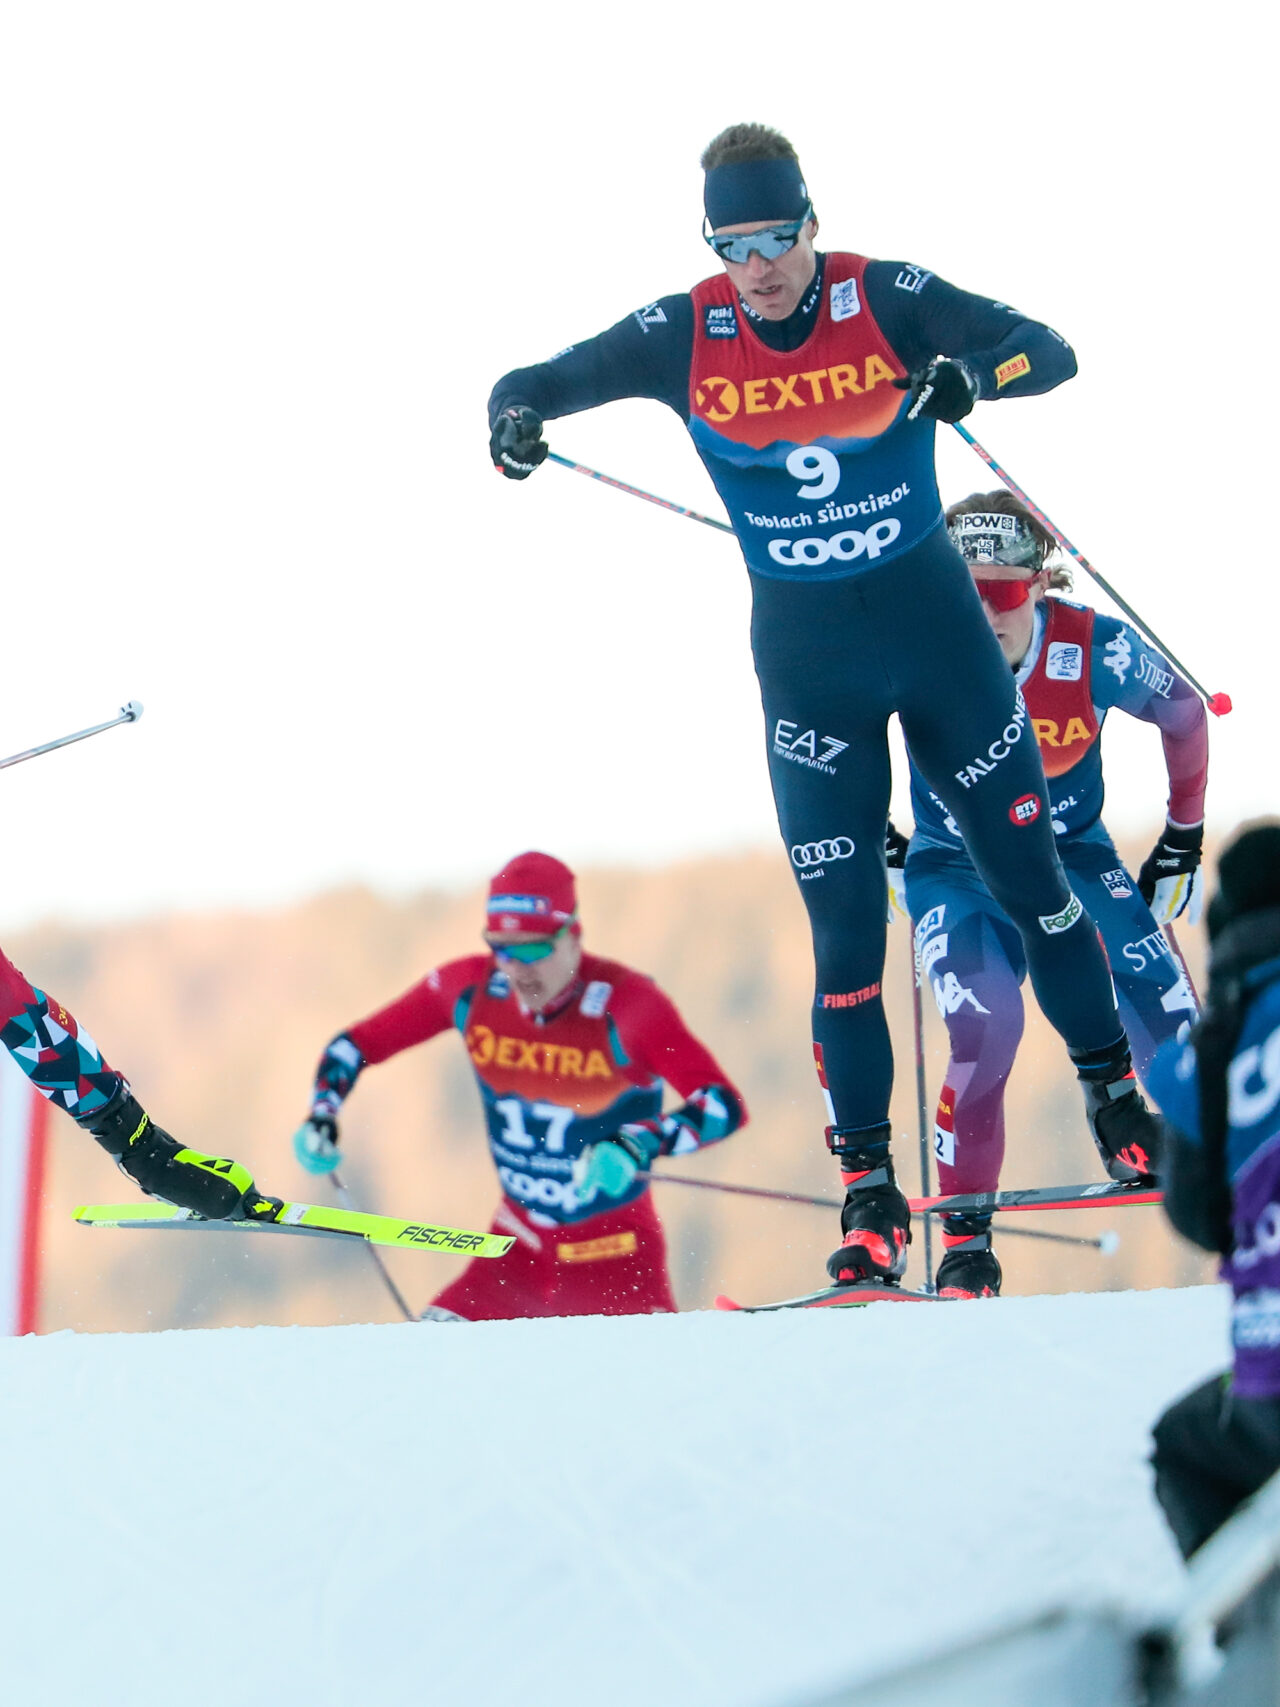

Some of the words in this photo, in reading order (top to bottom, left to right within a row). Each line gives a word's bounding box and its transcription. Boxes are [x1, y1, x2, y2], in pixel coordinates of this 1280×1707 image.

[744, 354, 897, 414] EXTRA
[907, 384, 934, 420] sportful
[785, 446, 841, 500] 9
[744, 511, 813, 529] Toblach
[767, 517, 902, 566] coop
[964, 515, 1001, 528] POW
[1135, 653, 1175, 699] STIFEL
[774, 719, 849, 763] EA7
[954, 684, 1026, 789] FALCONE
[800, 868, 825, 880] Audi
[1103, 870, 1123, 882] US
[496, 1036, 612, 1078] EXTRA
[495, 1099, 574, 1152] 17
[397, 1225, 485, 1251] FISCHER
